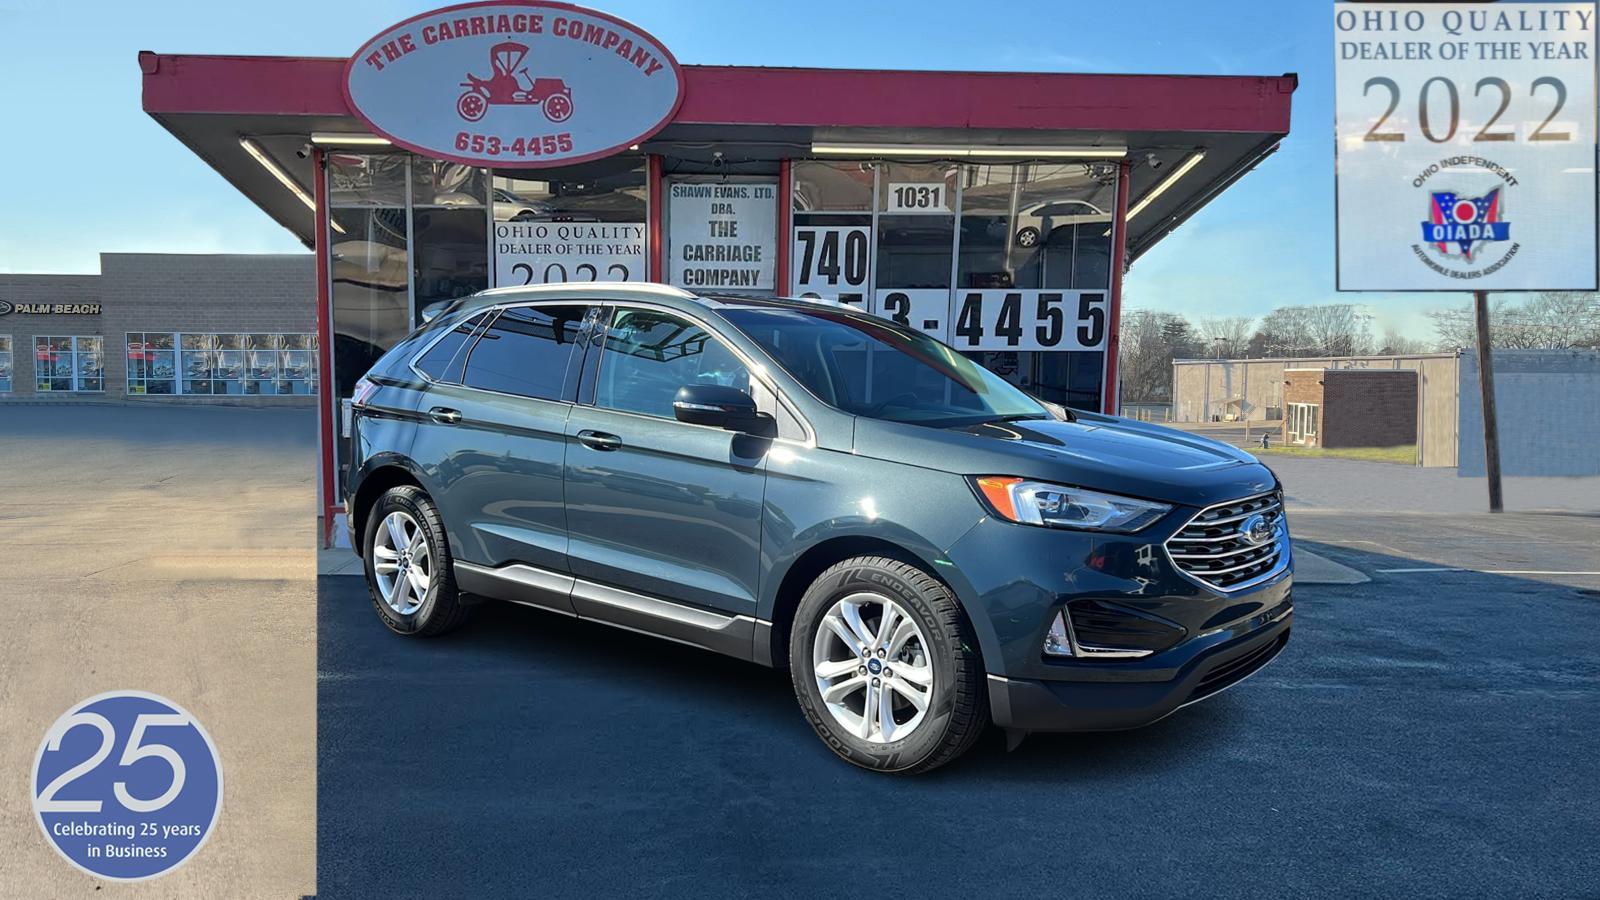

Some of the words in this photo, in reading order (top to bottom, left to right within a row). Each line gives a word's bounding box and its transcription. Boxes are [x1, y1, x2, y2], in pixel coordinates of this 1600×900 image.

[1336, 10, 1425, 32] OHIO
[1442, 10, 1592, 36] QUALITY
[365, 33, 417, 72] THE
[421, 14, 543, 46] CARRIAGE
[552, 17, 664, 78] COMPANY
[1341, 41, 1433, 61] DEALER
[1438, 41, 1469, 60] OF
[1475, 41, 1522, 60] THE
[1528, 41, 1589, 60] YEAR
[1363, 76, 1571, 144] 2022
[454, 131, 574, 157] 653-4455
[1412, 163, 1440, 189] OHIO
[1440, 155, 1519, 188] INDEPENDENT
[672, 186, 712, 199] SHAWN
[754, 187, 775, 199] LTD.
[894, 187, 940, 209] 1031
[711, 203, 736, 215] DBA.
[496, 225, 549, 239] OHIO
[557, 226, 644, 241] QUALITY
[708, 220, 738, 238] THE
[1432, 224, 1496, 241] OIADA
[499, 243, 552, 255] DEALER
[555, 243, 574, 255] OF
[576, 243, 603, 255] THE
[606, 244, 641, 256] YEAR
[682, 244, 762, 263] CARRIAGE
[797, 230, 868, 287] 740
[1410, 243, 1451, 277] AUTOMOBILE
[1449, 269, 1482, 280] DEALERS
[683, 268, 761, 286] COMPANY
[14, 303, 51, 314] PALM
[54, 303, 100, 315] BEACH
[870, 572, 943, 642] ENDEAVOR
